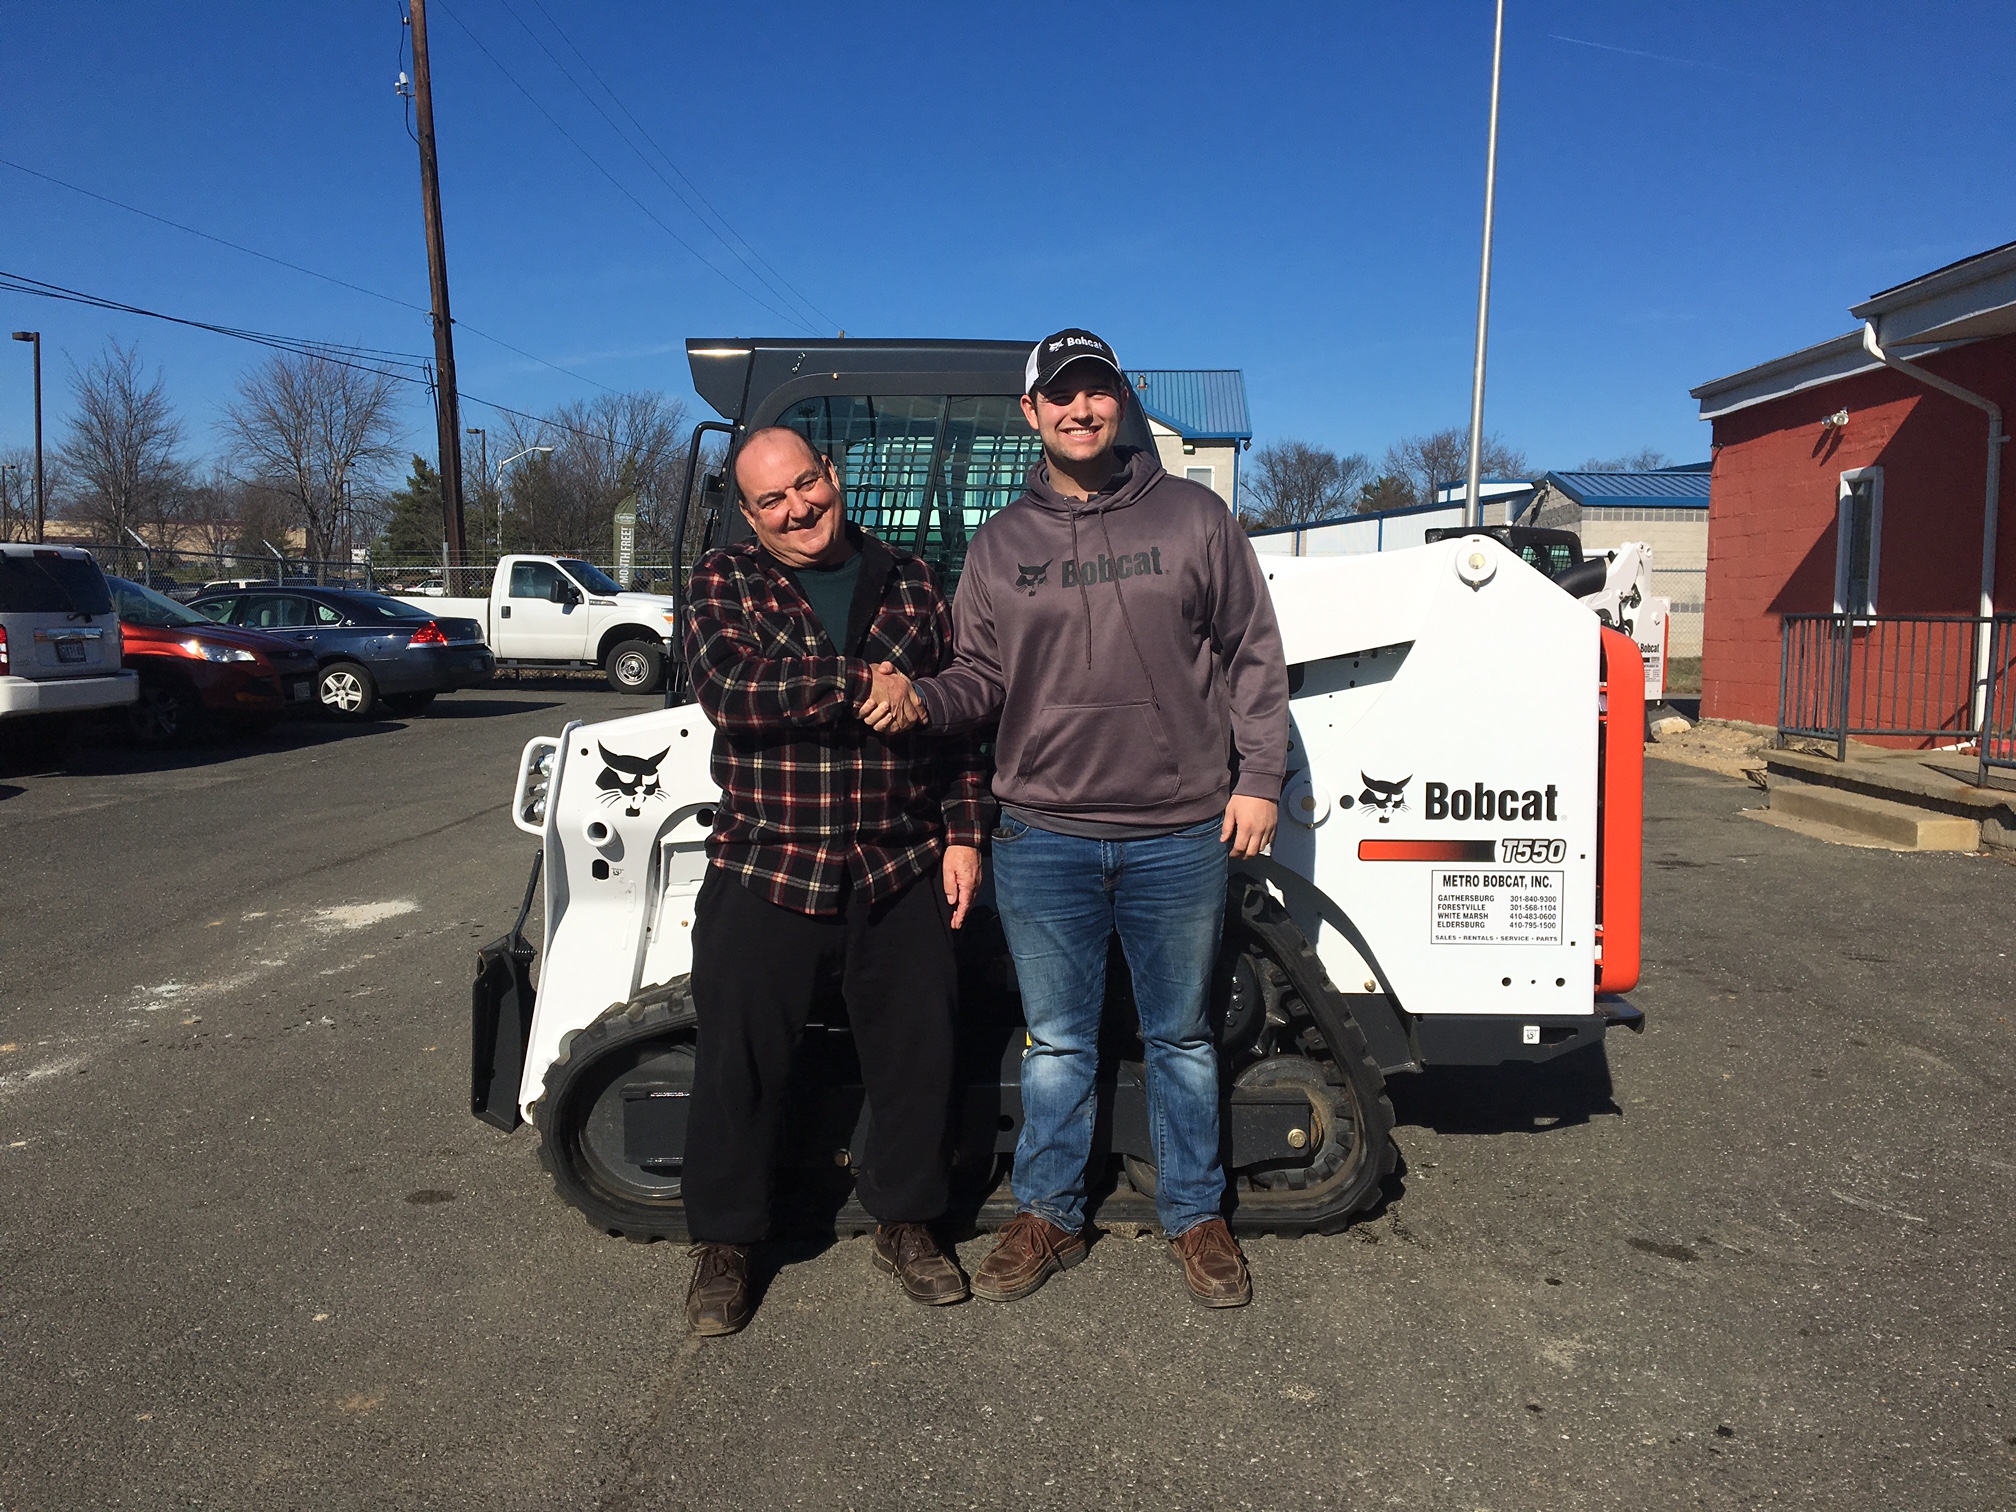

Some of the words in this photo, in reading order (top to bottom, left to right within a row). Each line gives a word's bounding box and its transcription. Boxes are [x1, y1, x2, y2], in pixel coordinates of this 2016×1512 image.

[1066, 336, 1103, 350] Bobcat
[619, 552, 630, 584] MONTH
[1061, 546, 1163, 589] Bobcat
[1641, 643, 1659, 653] Bobcat
[1425, 781, 1558, 821] Bobcat
[1501, 838, 1567, 863] T550
[1442, 874, 1480, 887] METRO
[1483, 875, 1528, 890] BOBCAT,
[1531, 875, 1552, 888] INC.
[1438, 894, 1495, 902] GAITHERSBURG
[1510, 895, 1557, 903] 301-840-9300
[1509, 904, 1557, 912] 301-568-1104
[1463, 912, 1489, 920] MARSH
